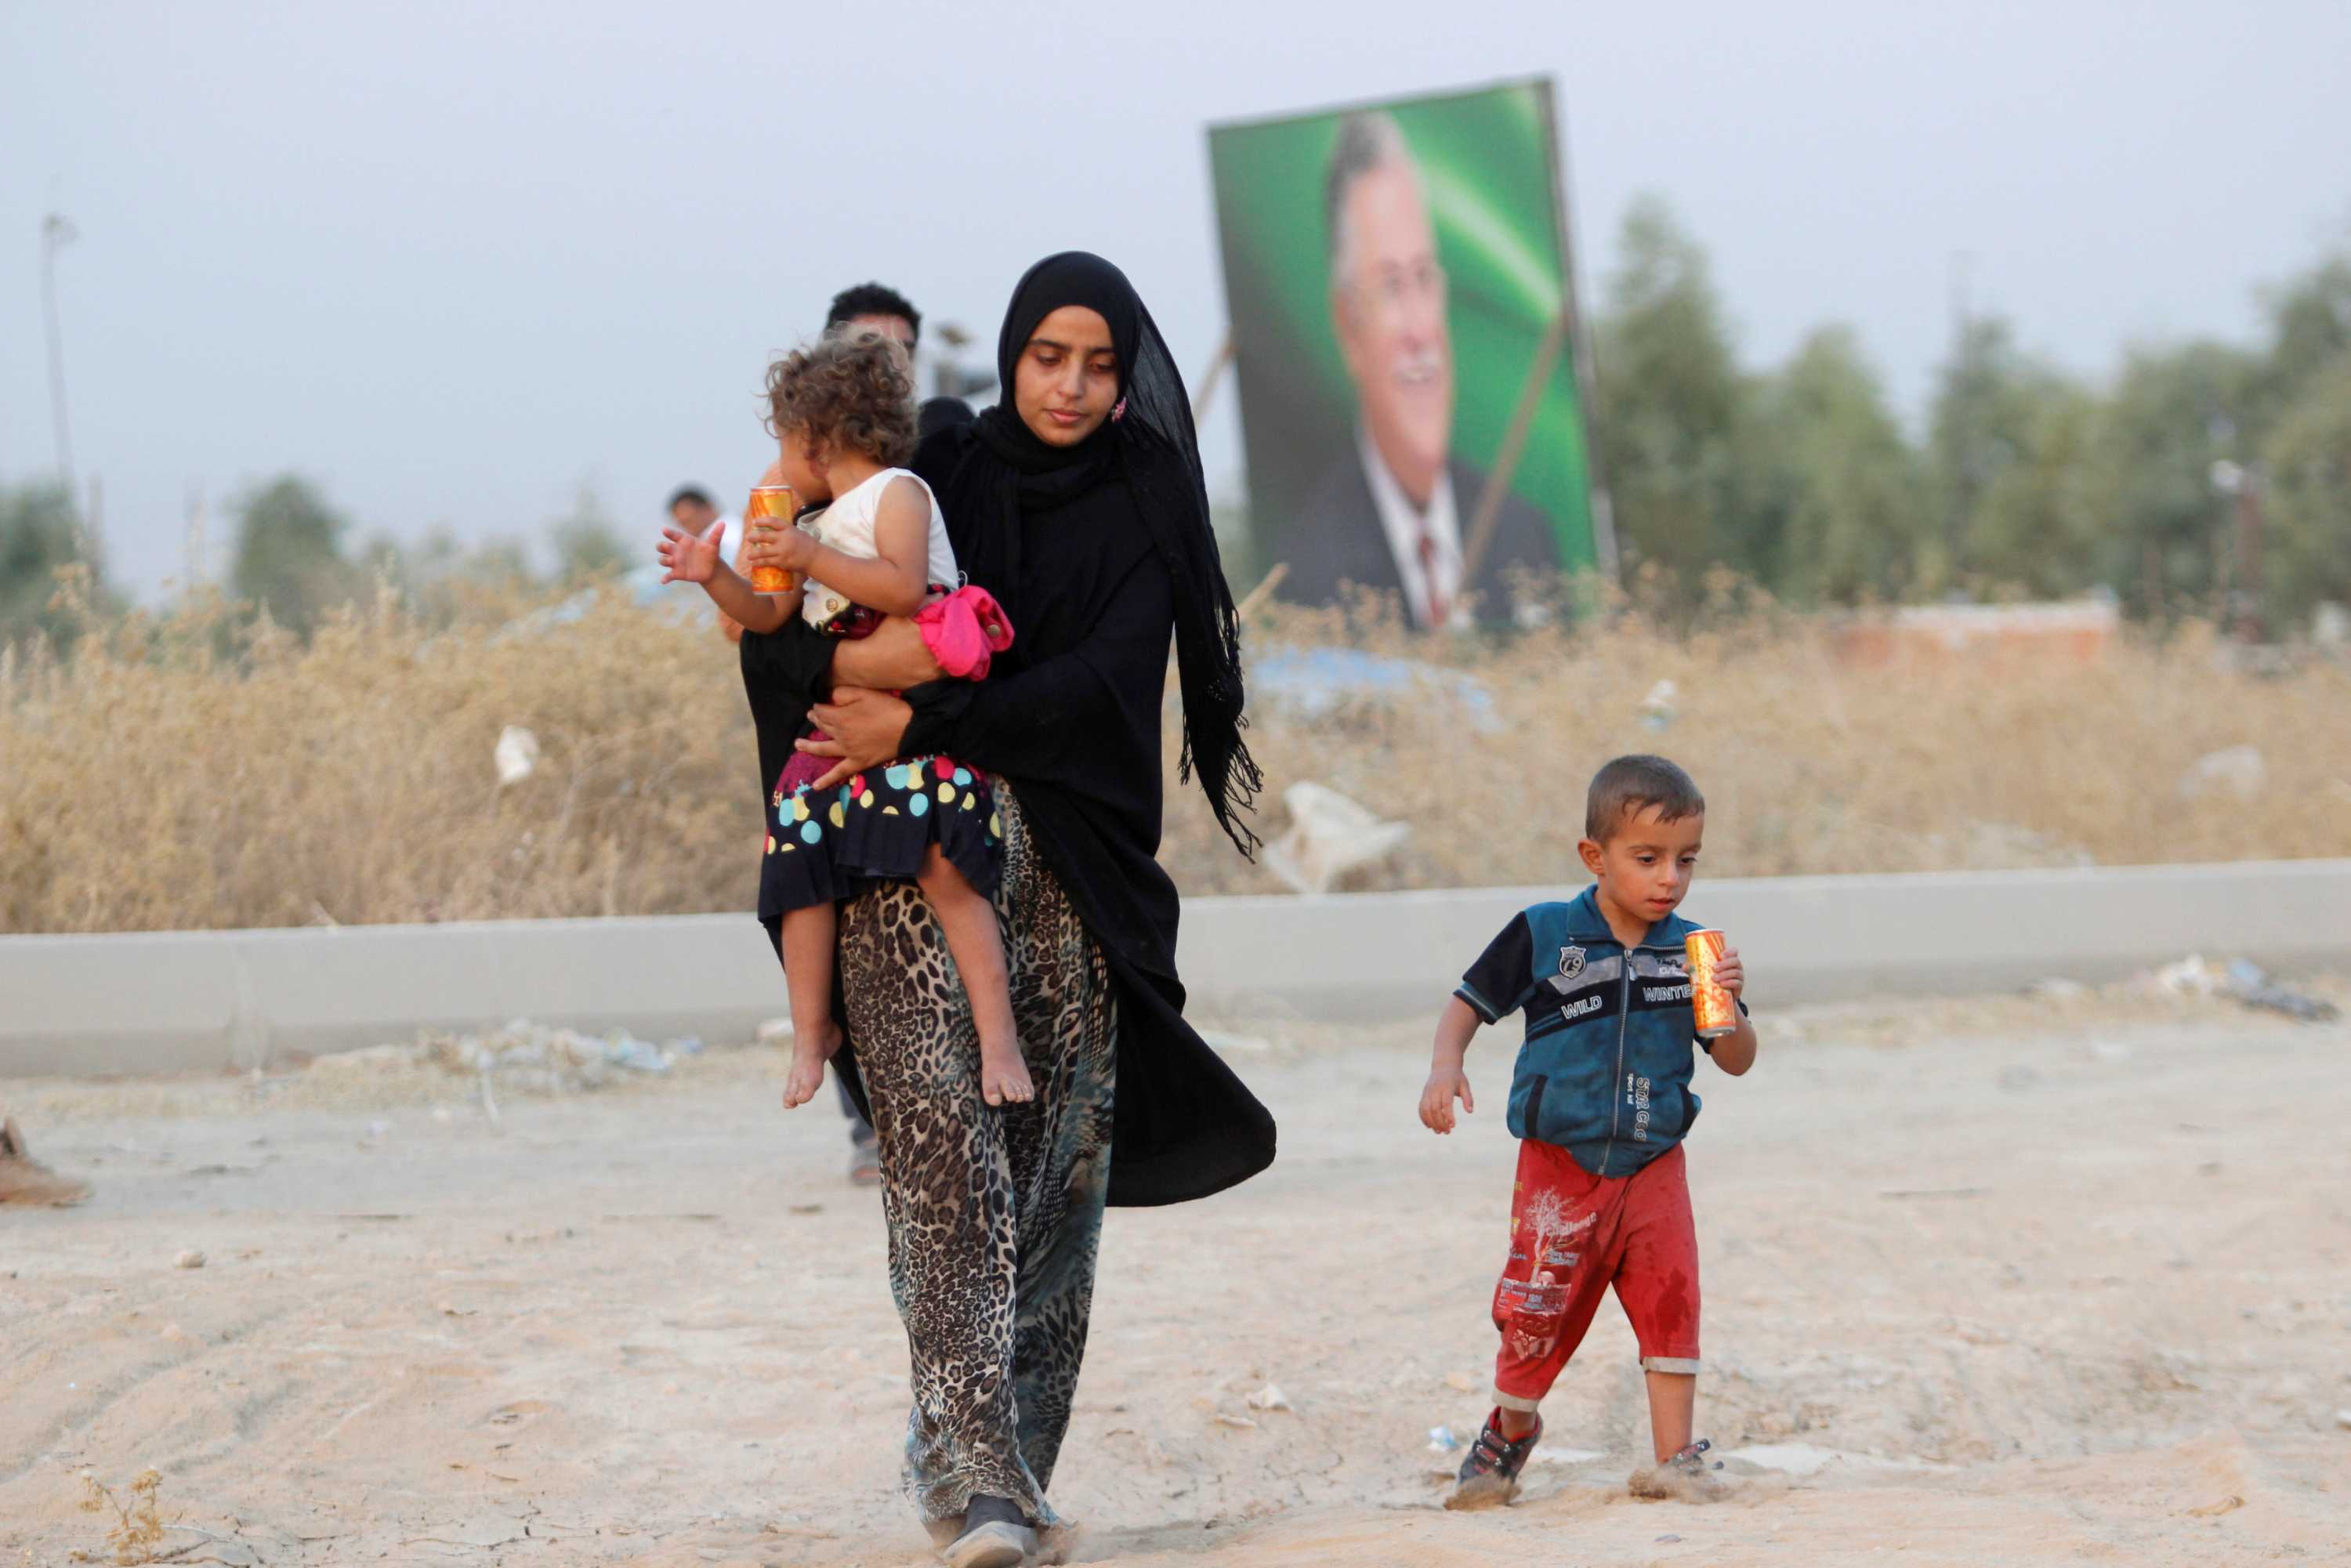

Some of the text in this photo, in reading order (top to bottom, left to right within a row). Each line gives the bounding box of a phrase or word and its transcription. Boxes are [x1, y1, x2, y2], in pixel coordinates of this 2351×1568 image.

[1642, 984, 1694, 1002] WINTE
[1560, 995, 1603, 1019] WILD
[1636, 1077, 1650, 1110] STAR
